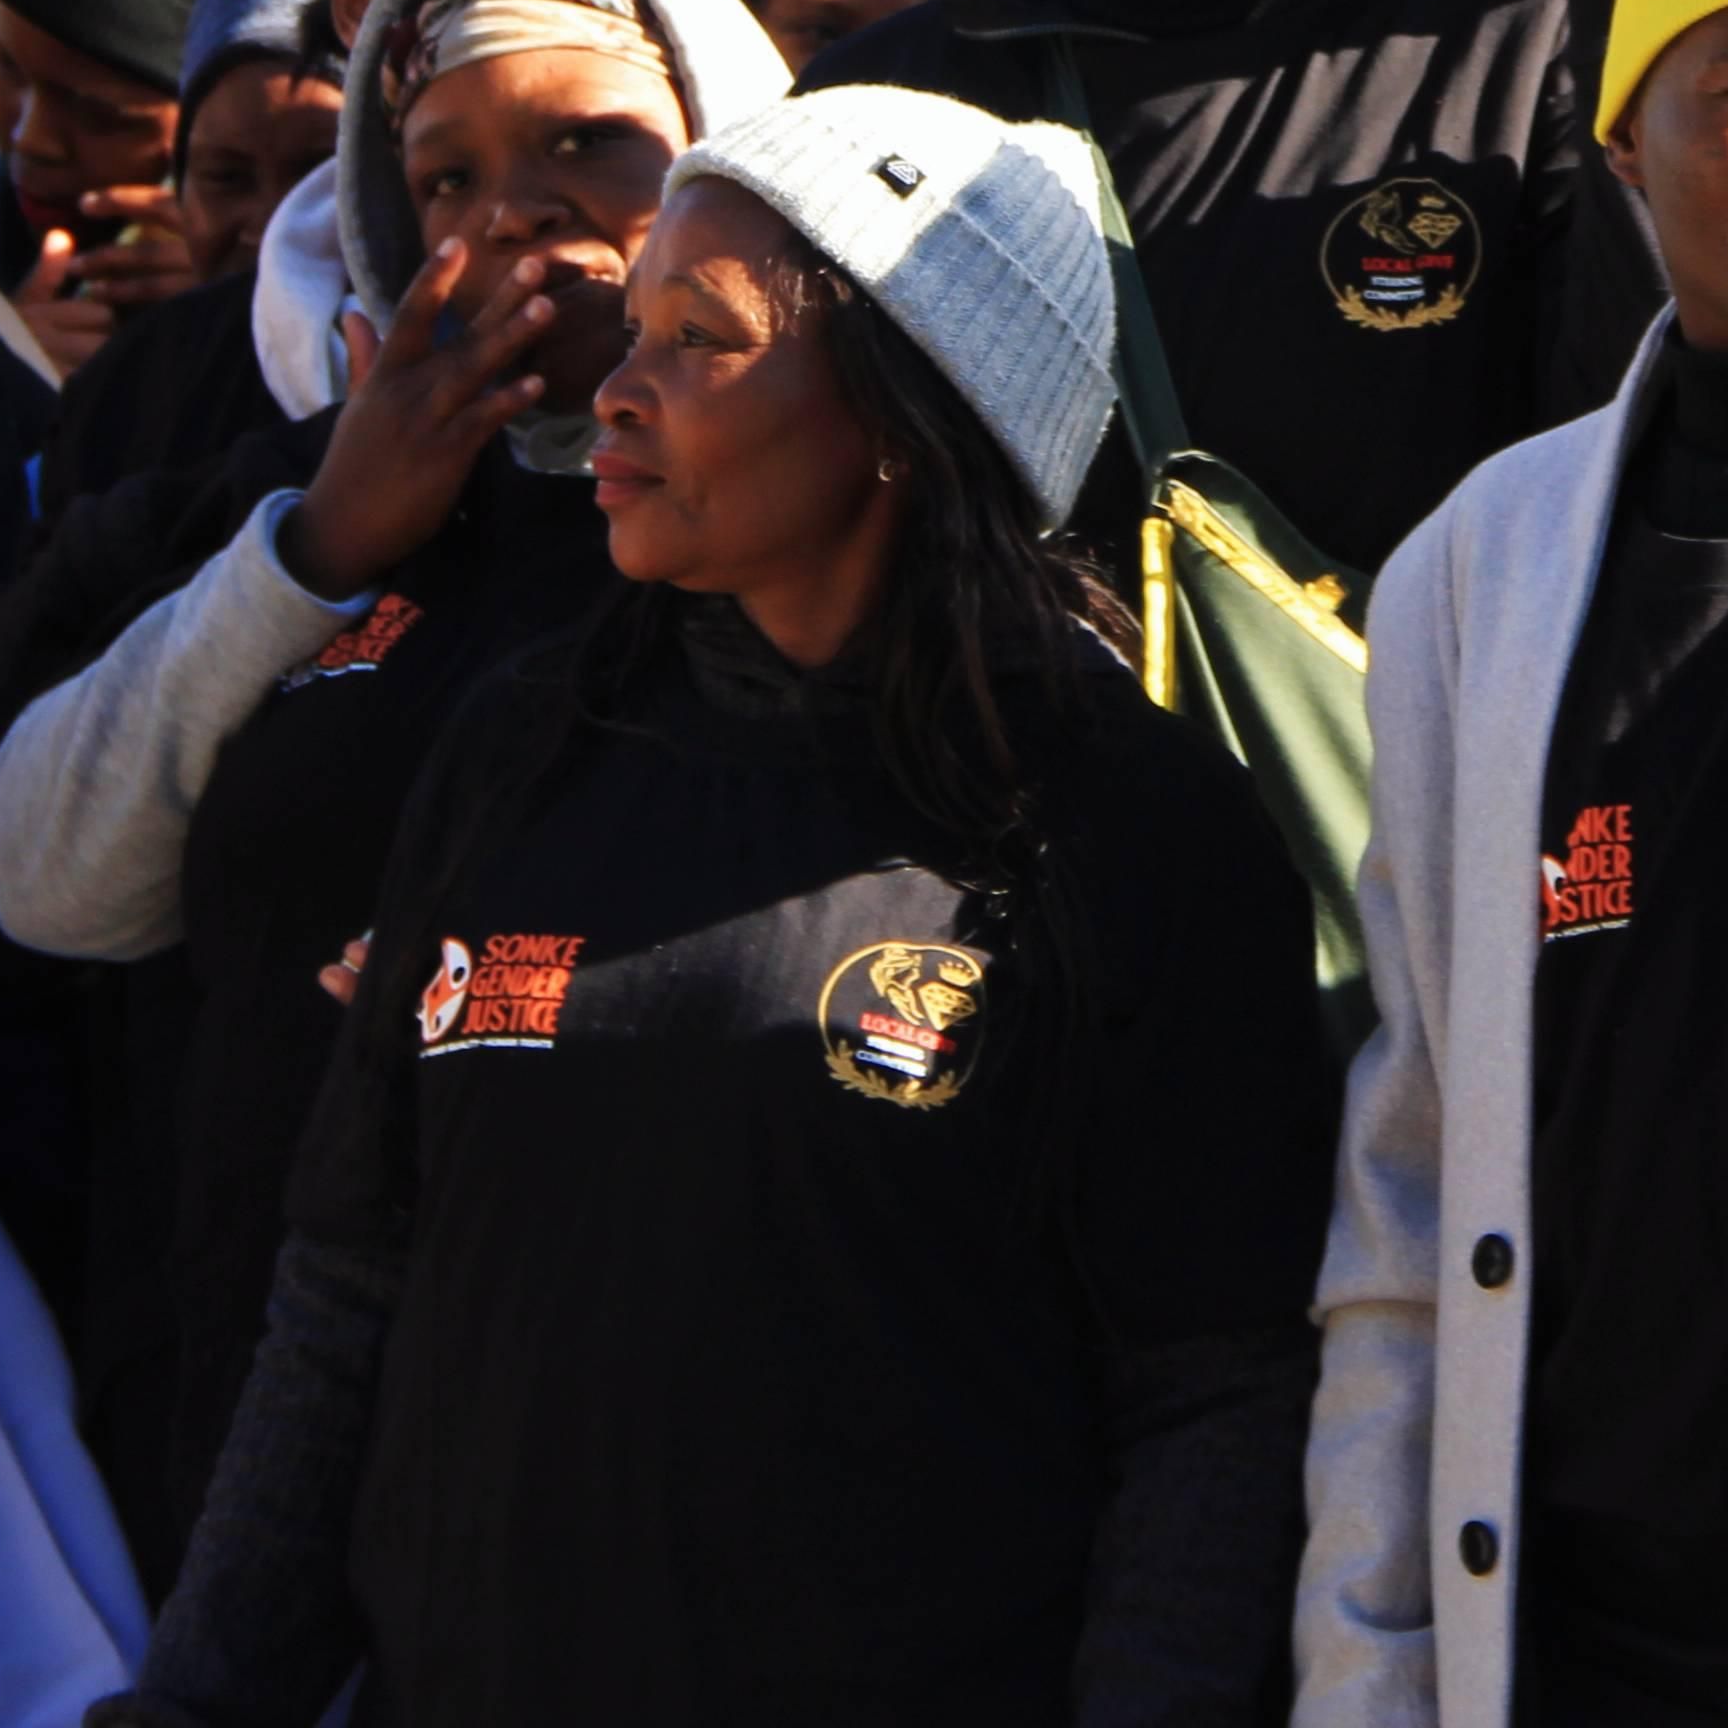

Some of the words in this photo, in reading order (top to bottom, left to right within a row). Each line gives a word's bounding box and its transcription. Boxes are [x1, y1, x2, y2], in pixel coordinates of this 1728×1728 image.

[480, 934, 585, 967] SONKE
[472, 965, 572, 1000] GENDER
[462, 1000, 563, 1034] JUSTICE
